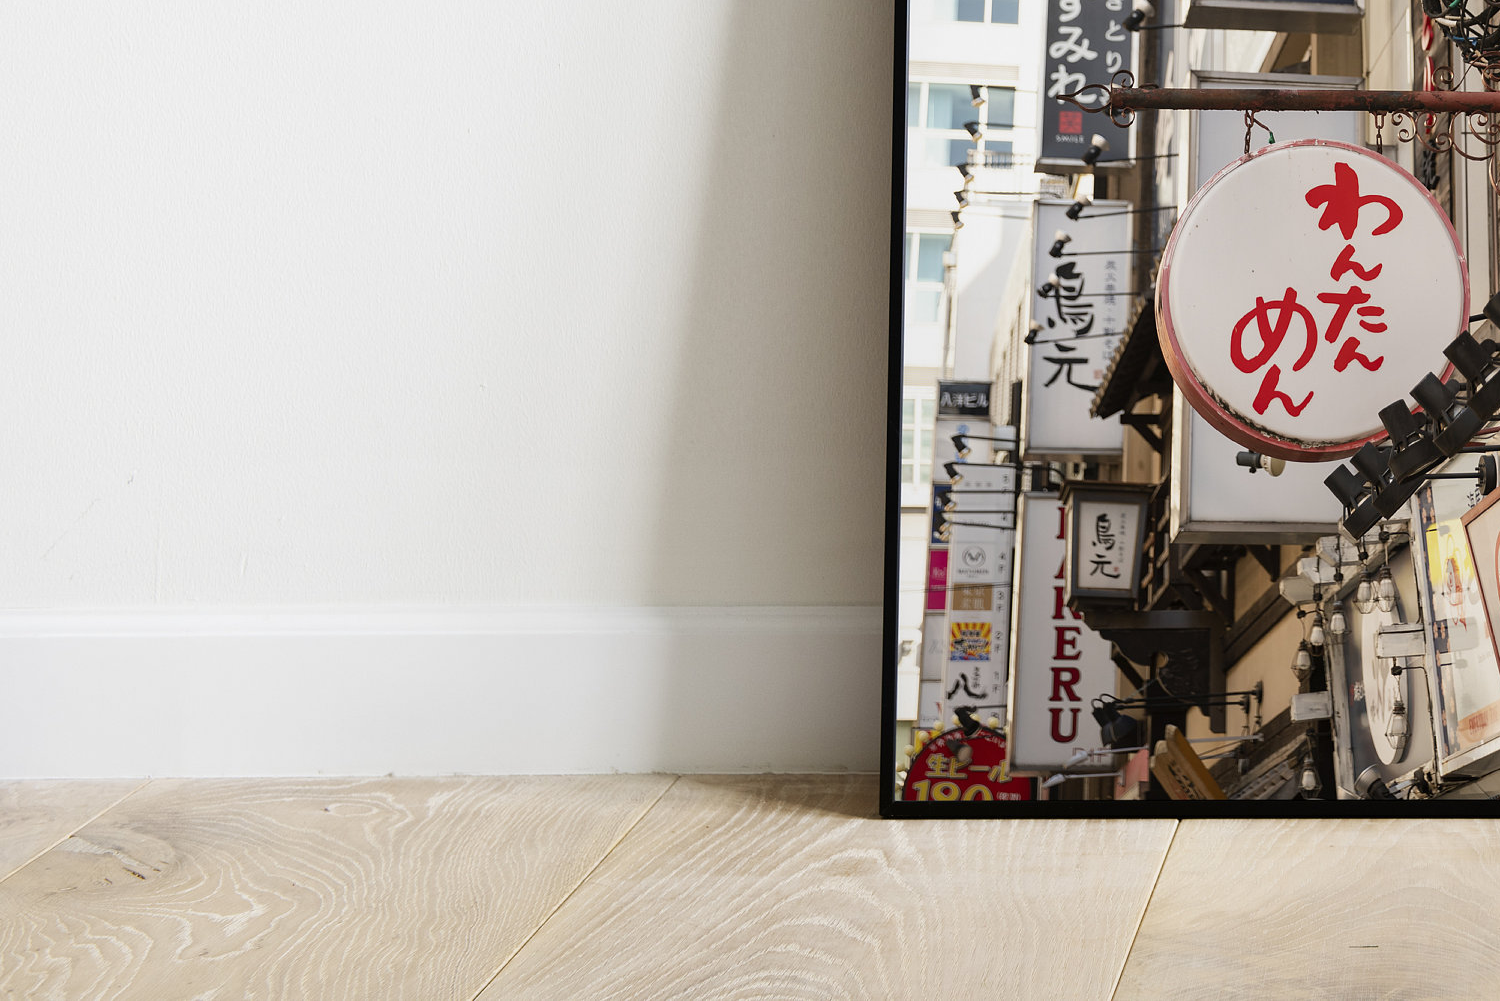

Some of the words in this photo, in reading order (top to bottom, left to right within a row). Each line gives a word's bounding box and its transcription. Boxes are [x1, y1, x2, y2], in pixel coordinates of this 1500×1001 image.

[1230, 286, 1319, 418] めん
[1305, 162, 1404, 372] わんたん
